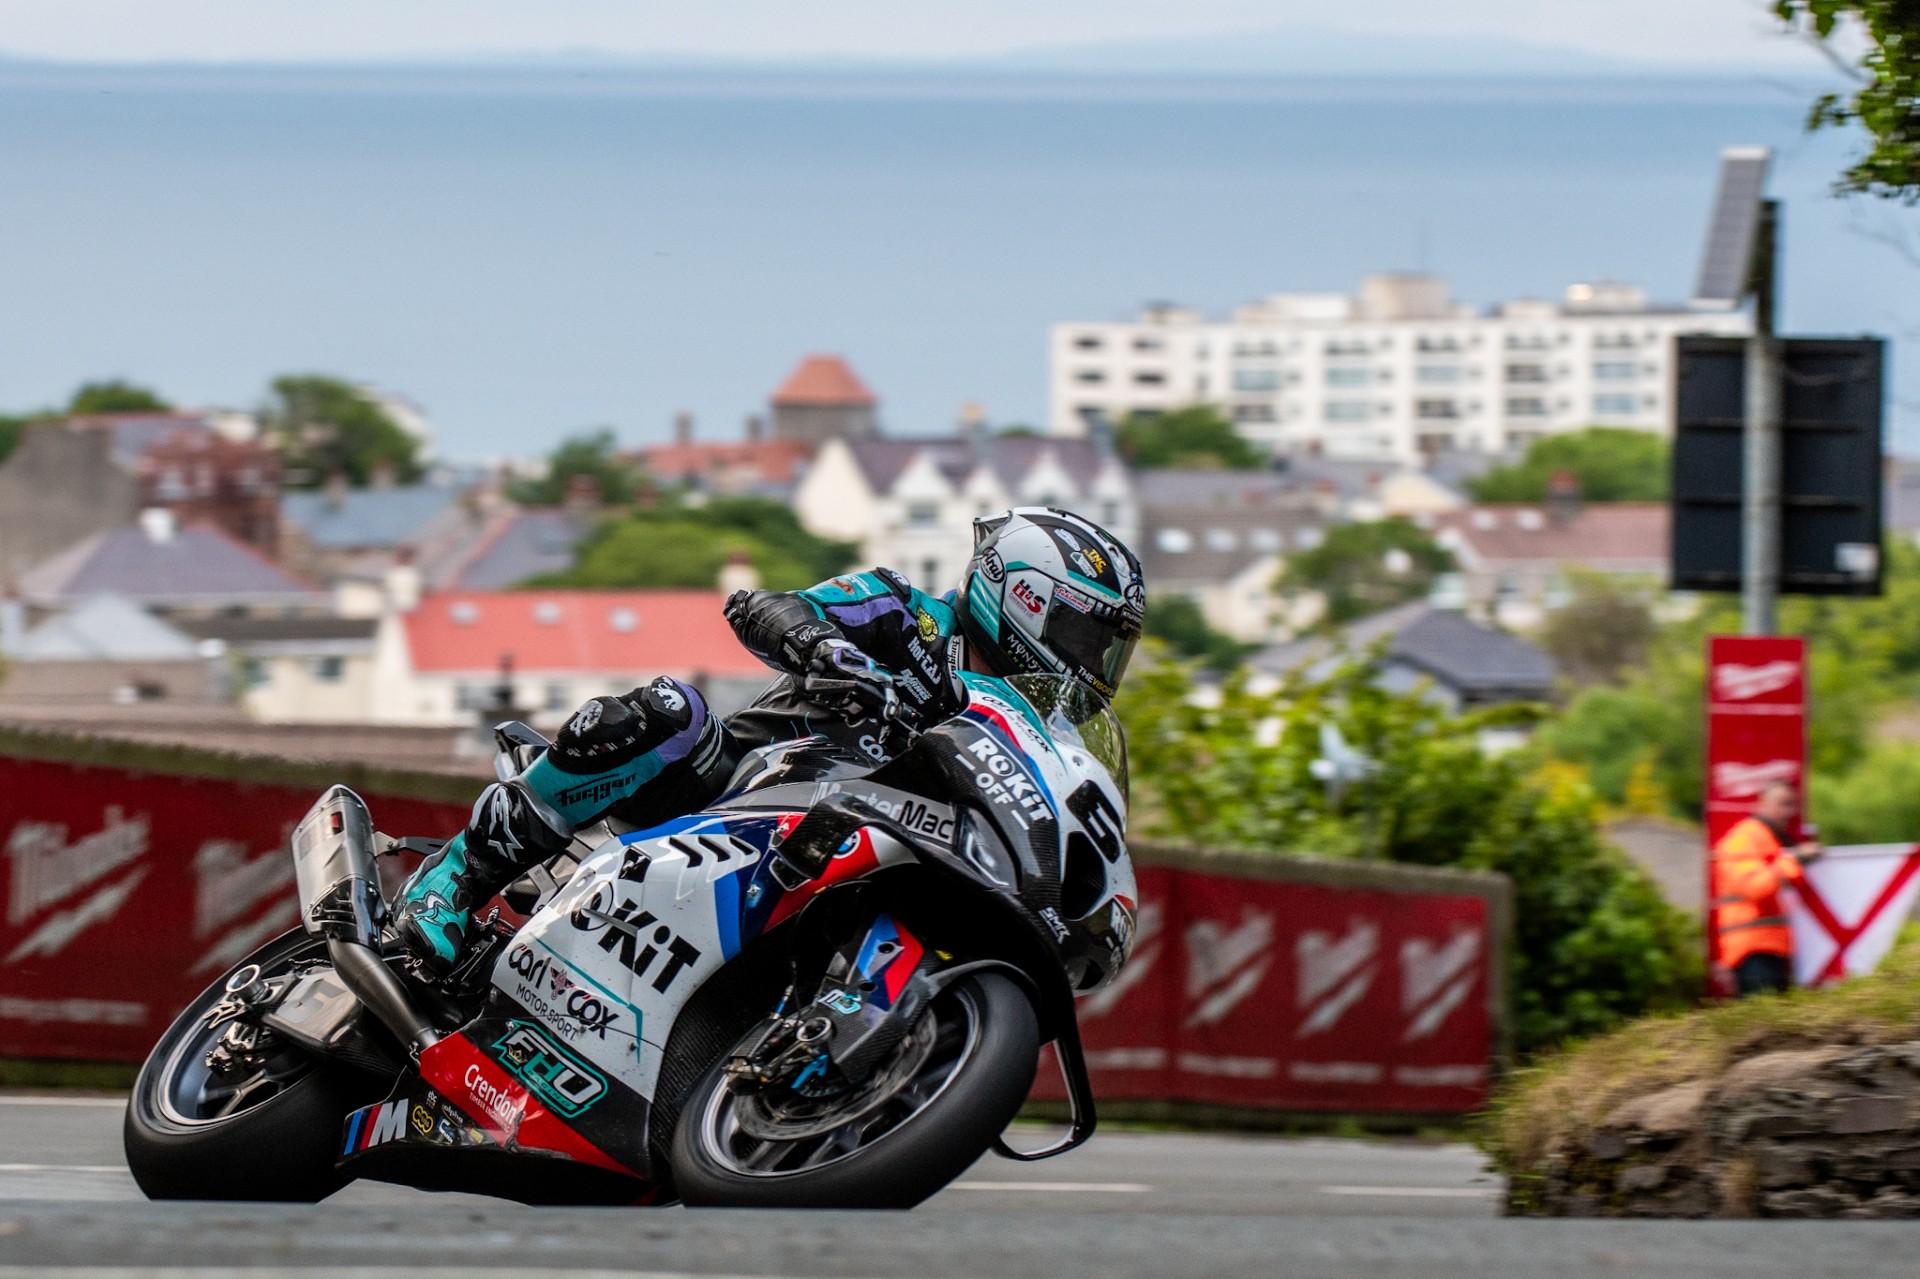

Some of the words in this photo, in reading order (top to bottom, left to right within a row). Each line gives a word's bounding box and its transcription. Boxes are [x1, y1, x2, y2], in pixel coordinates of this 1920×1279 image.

[984, 551, 1005, 579] Arai
[1012, 578, 1047, 614] H&S
[975, 772, 1014, 805] OFF
[570, 879, 702, 995] OKiT
[516, 982, 548, 1018] MOTOR
[547, 1008, 580, 1042] SPORT
[504, 1030, 603, 1104] FHO
[527, 1068, 573, 1109] RACING
[464, 1063, 518, 1126] Crendon
[367, 1098, 409, 1149] M
